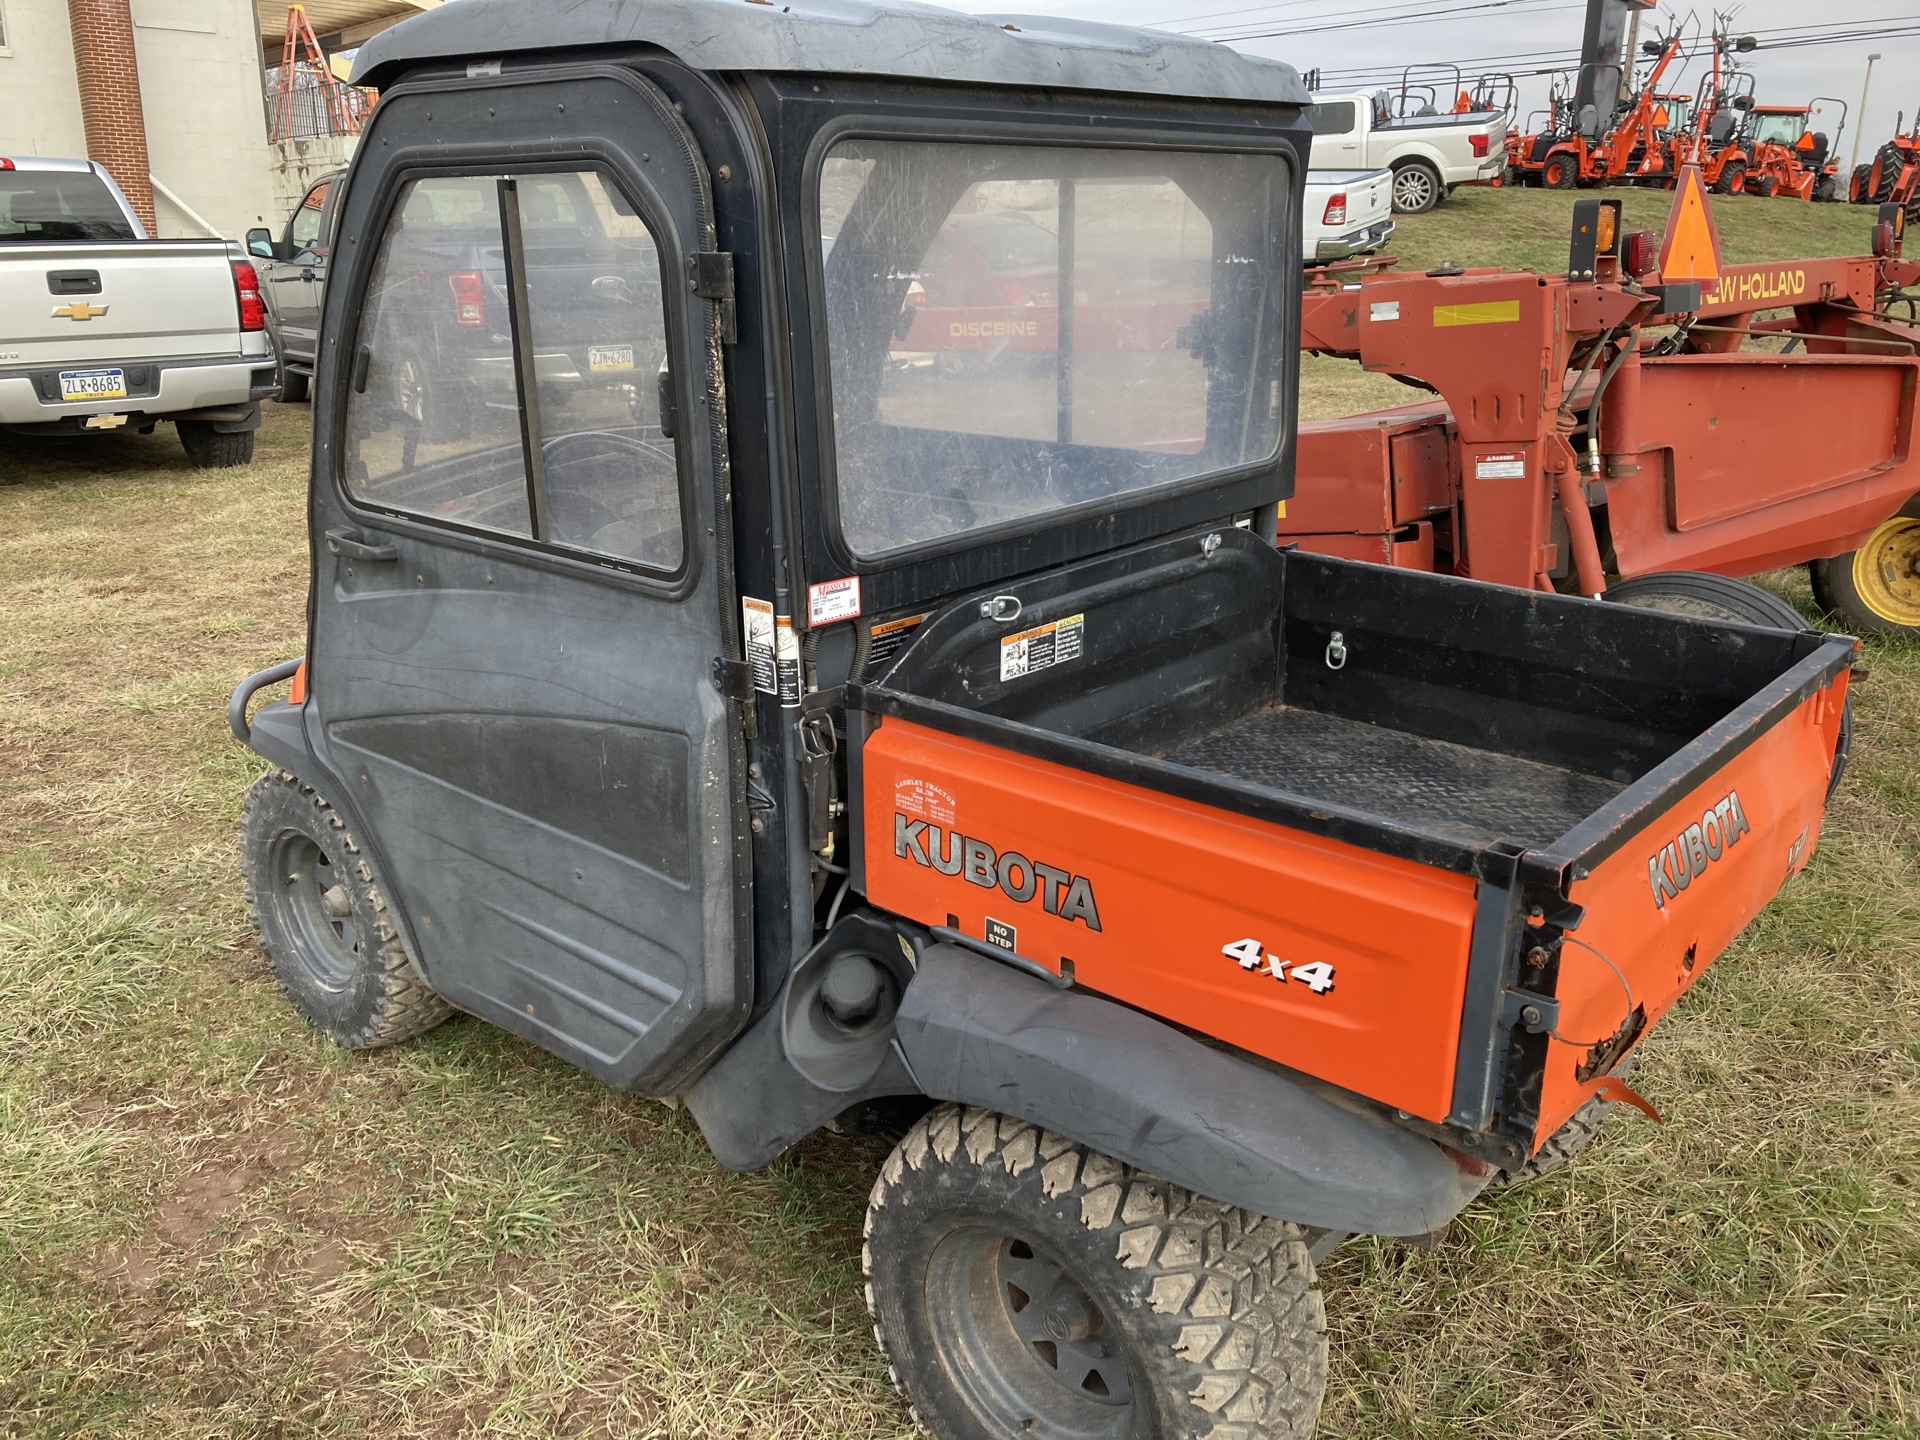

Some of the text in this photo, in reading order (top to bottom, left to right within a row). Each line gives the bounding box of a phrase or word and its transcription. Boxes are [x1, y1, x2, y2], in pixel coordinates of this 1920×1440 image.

[1740, 270, 1805, 301] HOLLAND
[949, 321, 1038, 337] DISCBINE
[925, 782, 956, 807] TRACTOR
[1648, 789, 1751, 910] KUBOTA
[895, 812, 1102, 933] KUBOTA
[988, 933, 1012, 949] STEP
[993, 924, 1008, 937] NO
[1221, 937, 1336, 996] 4x4
